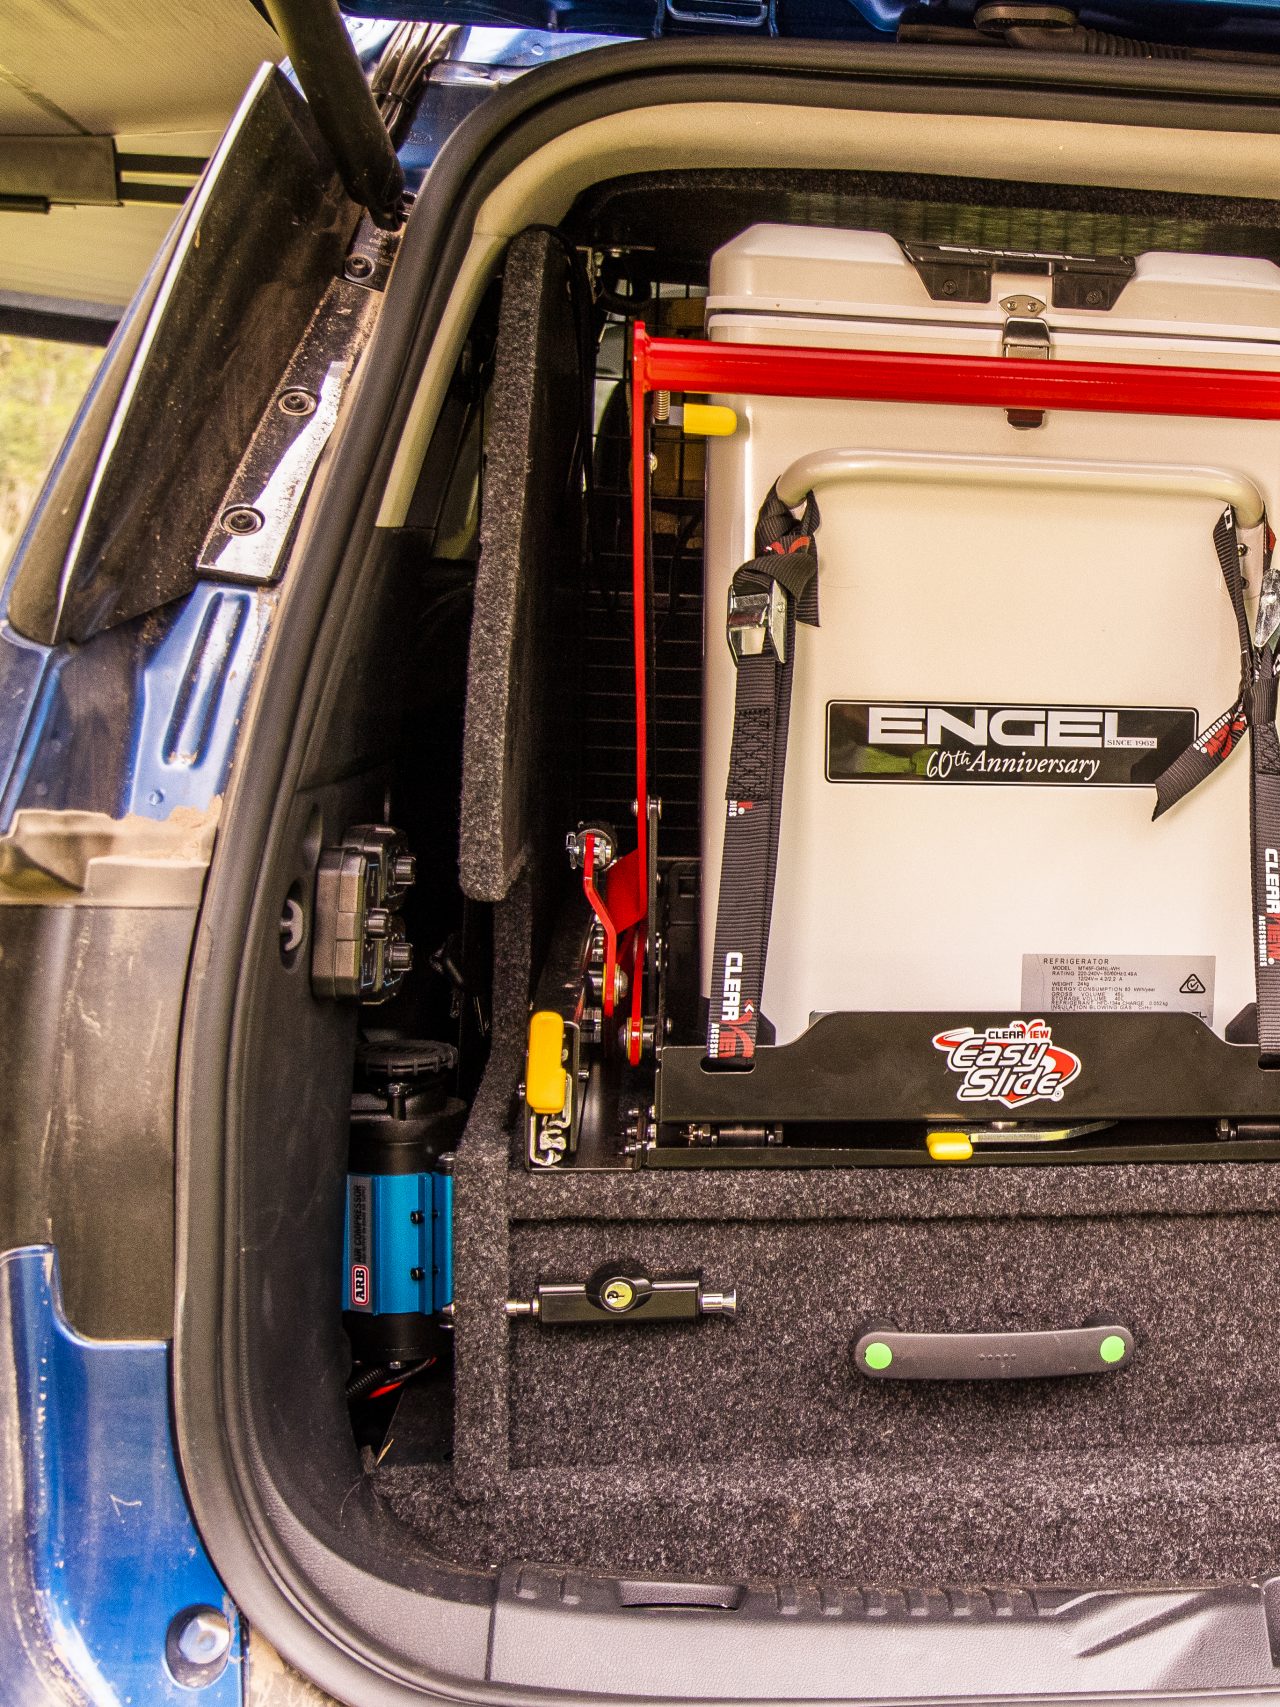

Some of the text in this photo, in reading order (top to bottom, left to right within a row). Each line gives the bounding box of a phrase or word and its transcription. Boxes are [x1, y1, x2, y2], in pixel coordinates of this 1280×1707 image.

[868, 706, 1158, 748] ENGEL
[968, 751, 1100, 780] Anniversary
[1258, 915, 1268, 967] ACCESSORIES
[1043, 957, 1109, 965] REFRIGERATOR
[951, 1037, 1050, 1072] Easy
[961, 1062, 1063, 1097] Slide
[353, 1185, 362, 1245] COMPRESSOR
[355, 1269, 365, 1300] ARB
